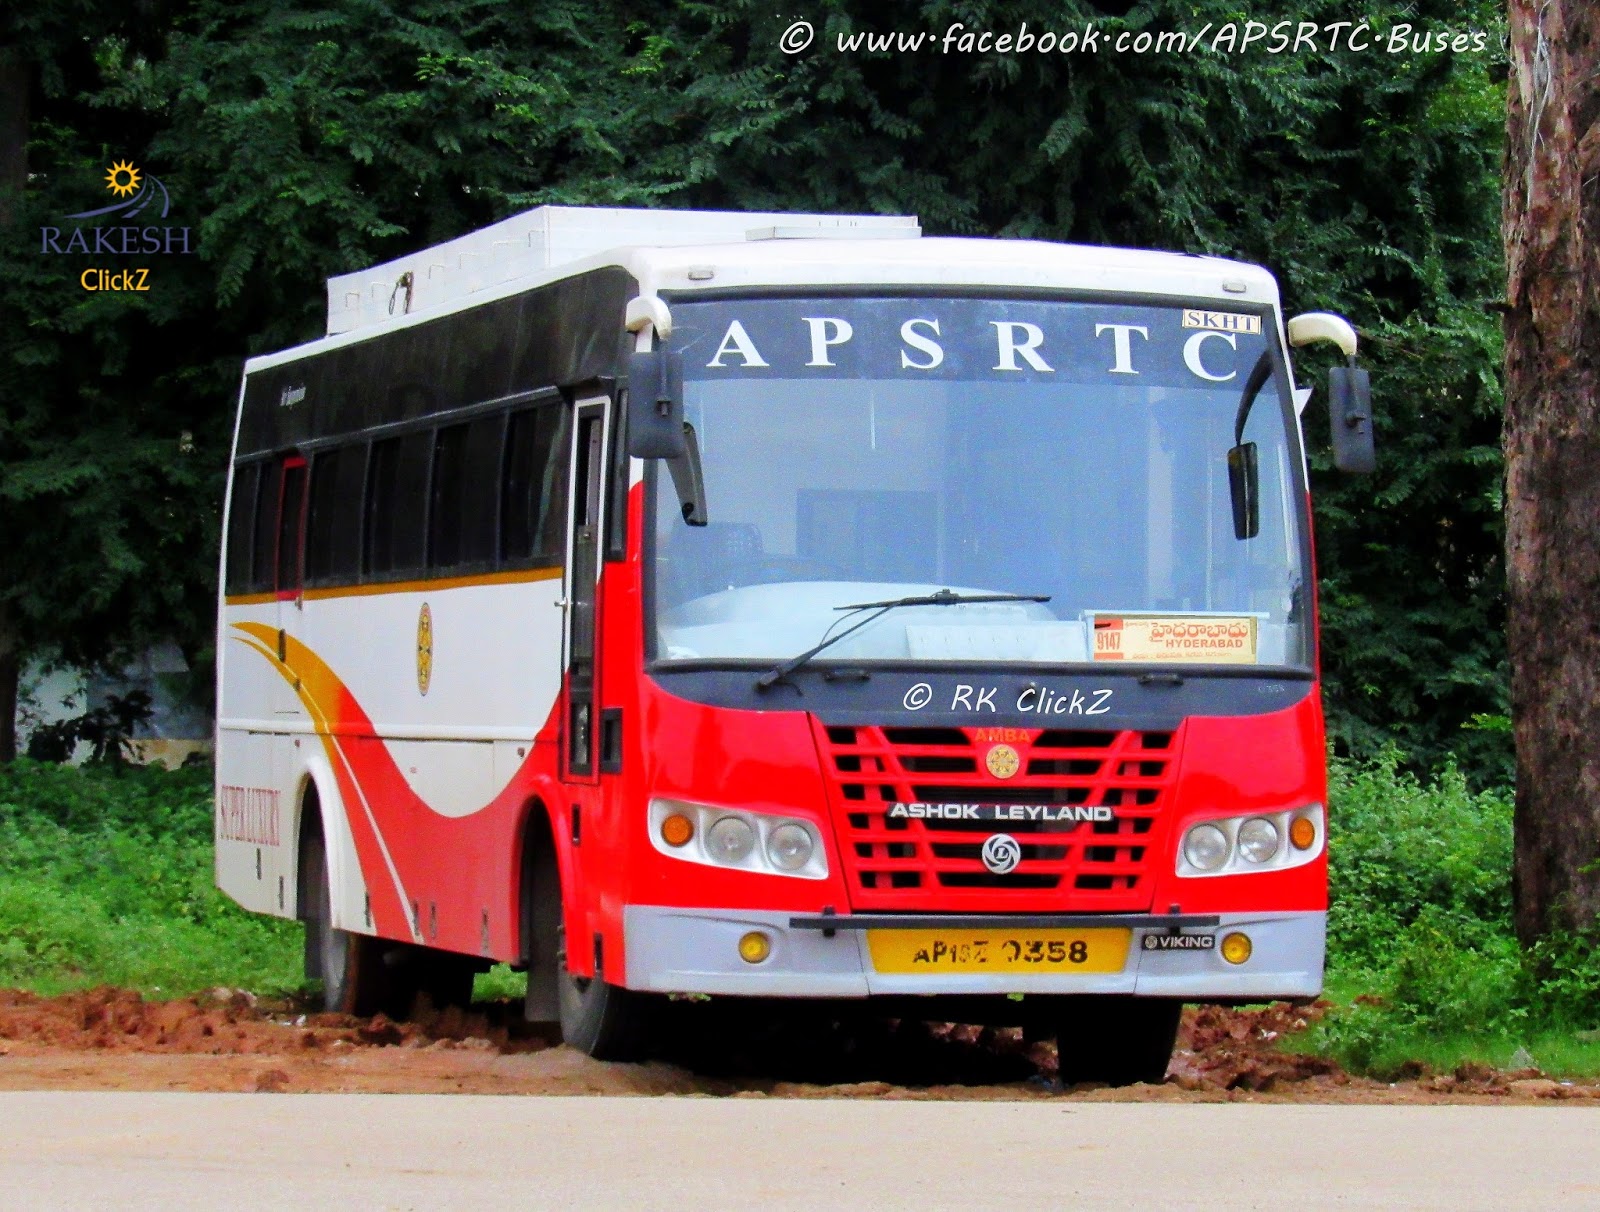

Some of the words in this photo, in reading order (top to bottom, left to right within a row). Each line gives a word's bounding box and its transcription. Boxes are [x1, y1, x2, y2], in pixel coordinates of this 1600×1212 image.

[1187, 310, 1257, 331] SKHT
[1097, 632, 1120, 650] 9147
[1165, 639, 1243, 648] HYDERABAD
[974, 729, 1031, 742] AMBA
[890, 803, 980, 819] ASHOK
[995, 804, 1113, 821] LEYLAND
[1160, 935, 1213, 948] VIKING
[1001, 940, 1088, 963] 0358
